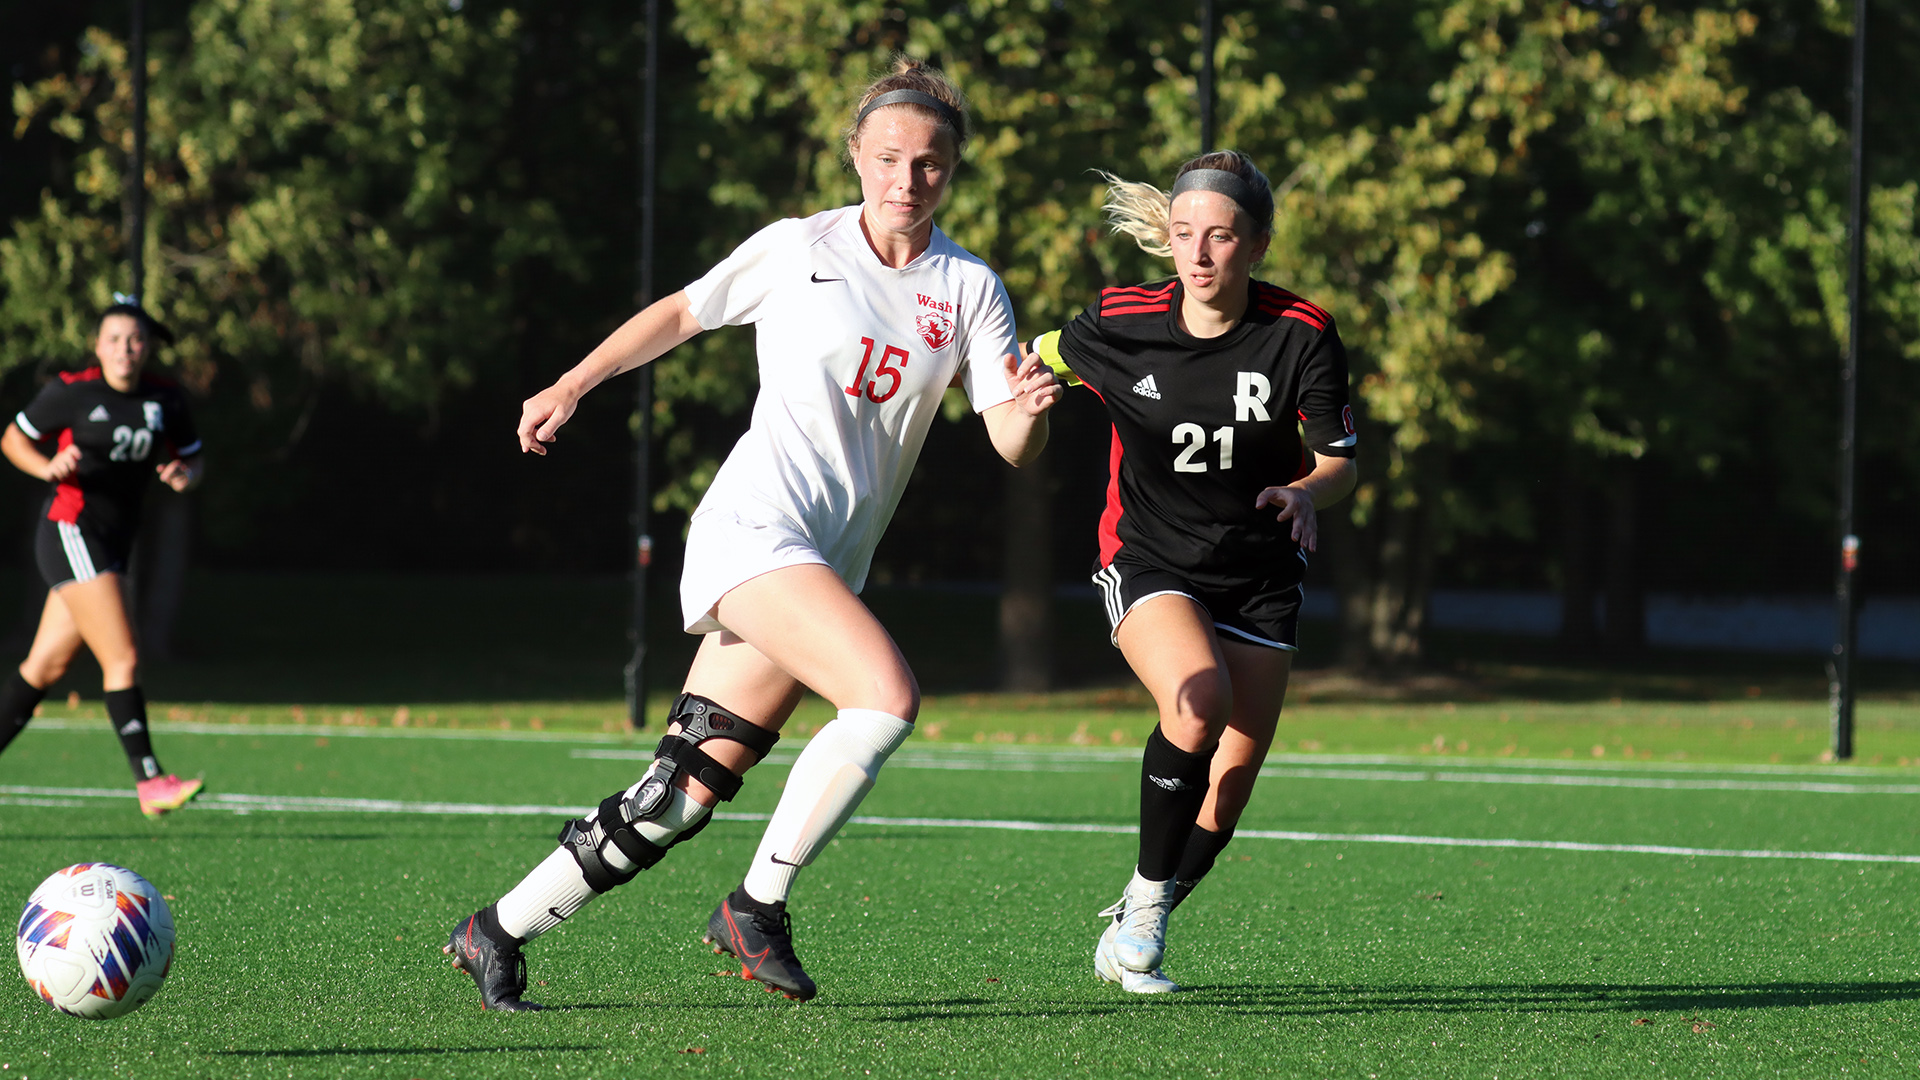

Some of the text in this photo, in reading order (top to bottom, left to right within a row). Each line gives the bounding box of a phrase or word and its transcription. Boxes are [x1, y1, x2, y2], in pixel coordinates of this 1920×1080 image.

[916, 293, 953, 313] Wash
[845, 336, 910, 404] 15
[1132, 385, 1161, 400] adidas
[1233, 371, 1271, 421] R
[110, 425, 153, 461] 20
[1171, 422, 1234, 472] 21
[1149, 774, 1193, 791] adid
[104, 879, 114, 899] NCAA
